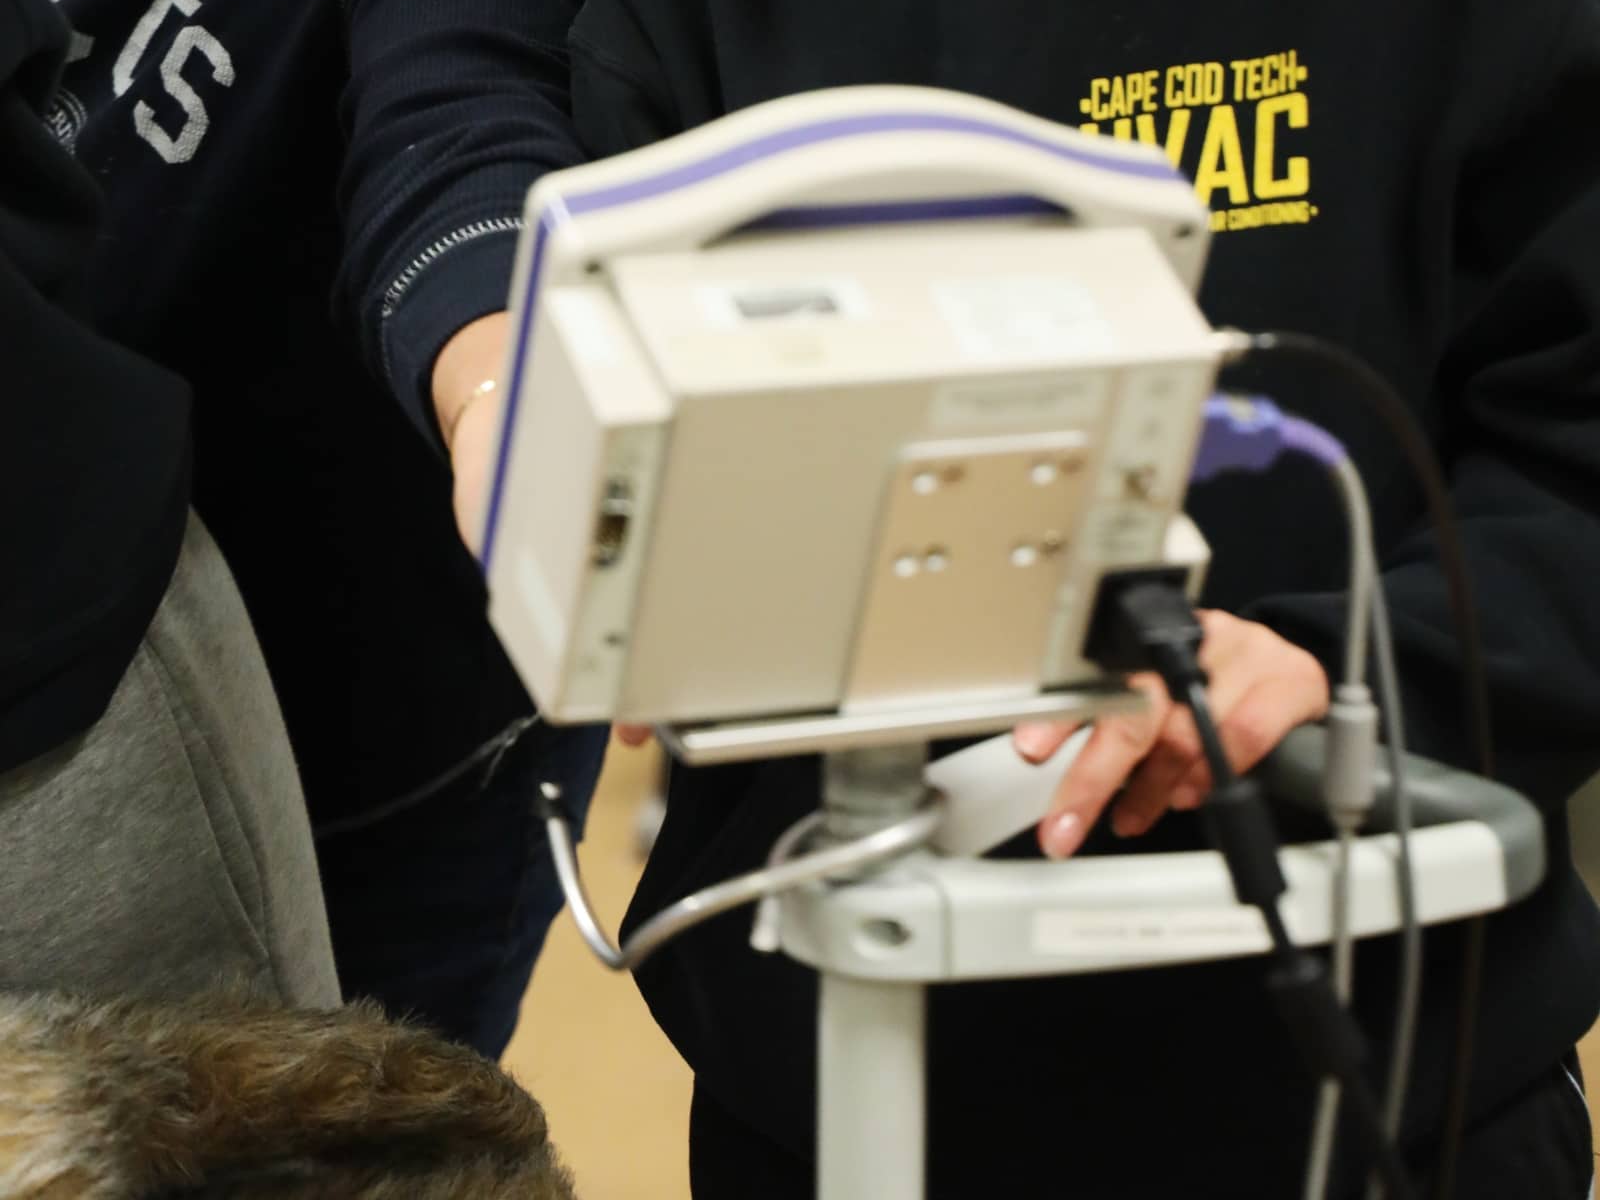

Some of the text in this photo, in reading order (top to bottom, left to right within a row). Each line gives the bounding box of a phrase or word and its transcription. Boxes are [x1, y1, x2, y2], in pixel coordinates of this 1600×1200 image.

[1091, 49, 1298, 121] CAPE COD TECH
[1080, 92, 1310, 205] AC
